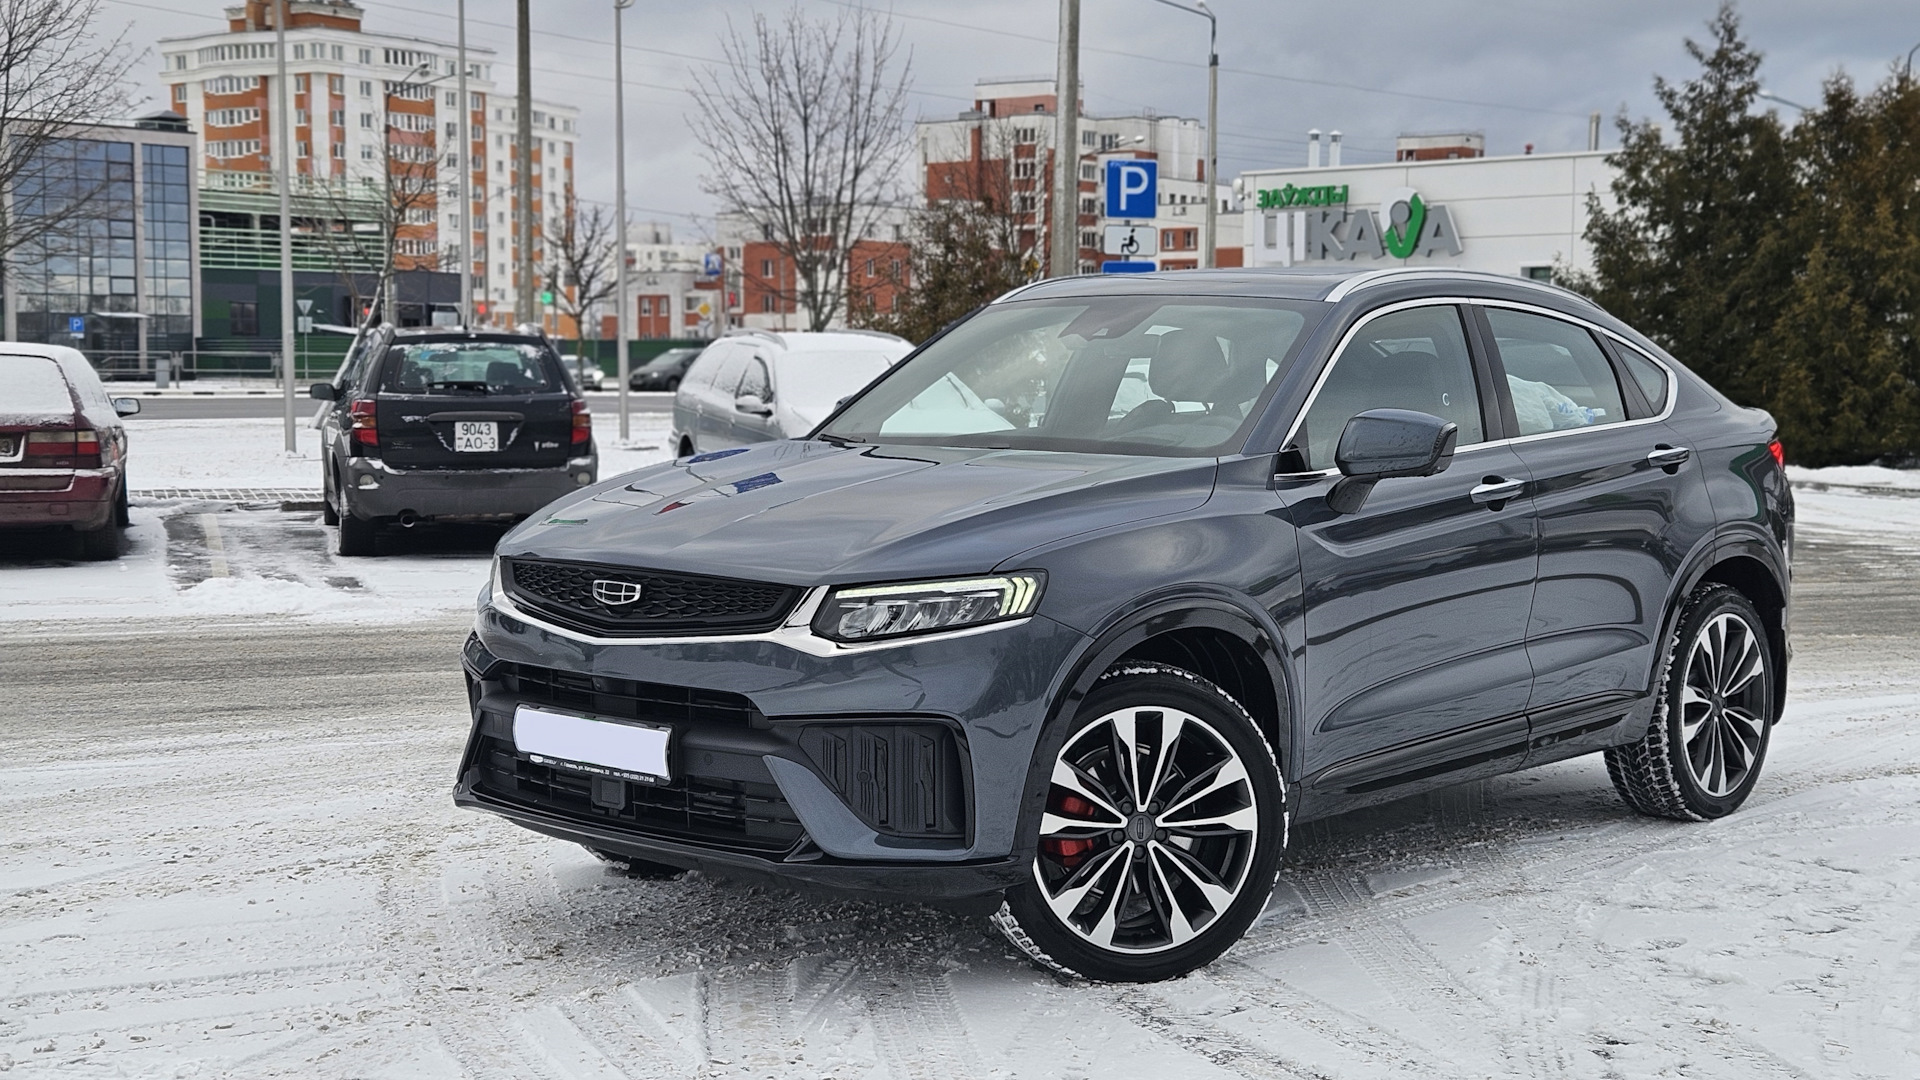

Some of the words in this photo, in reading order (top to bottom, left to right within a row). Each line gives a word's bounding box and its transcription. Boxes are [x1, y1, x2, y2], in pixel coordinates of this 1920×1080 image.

[1119, 165, 1149, 211] P
[461, 423, 492, 436] 9043
[464, 437, 496, 449] AO-3
